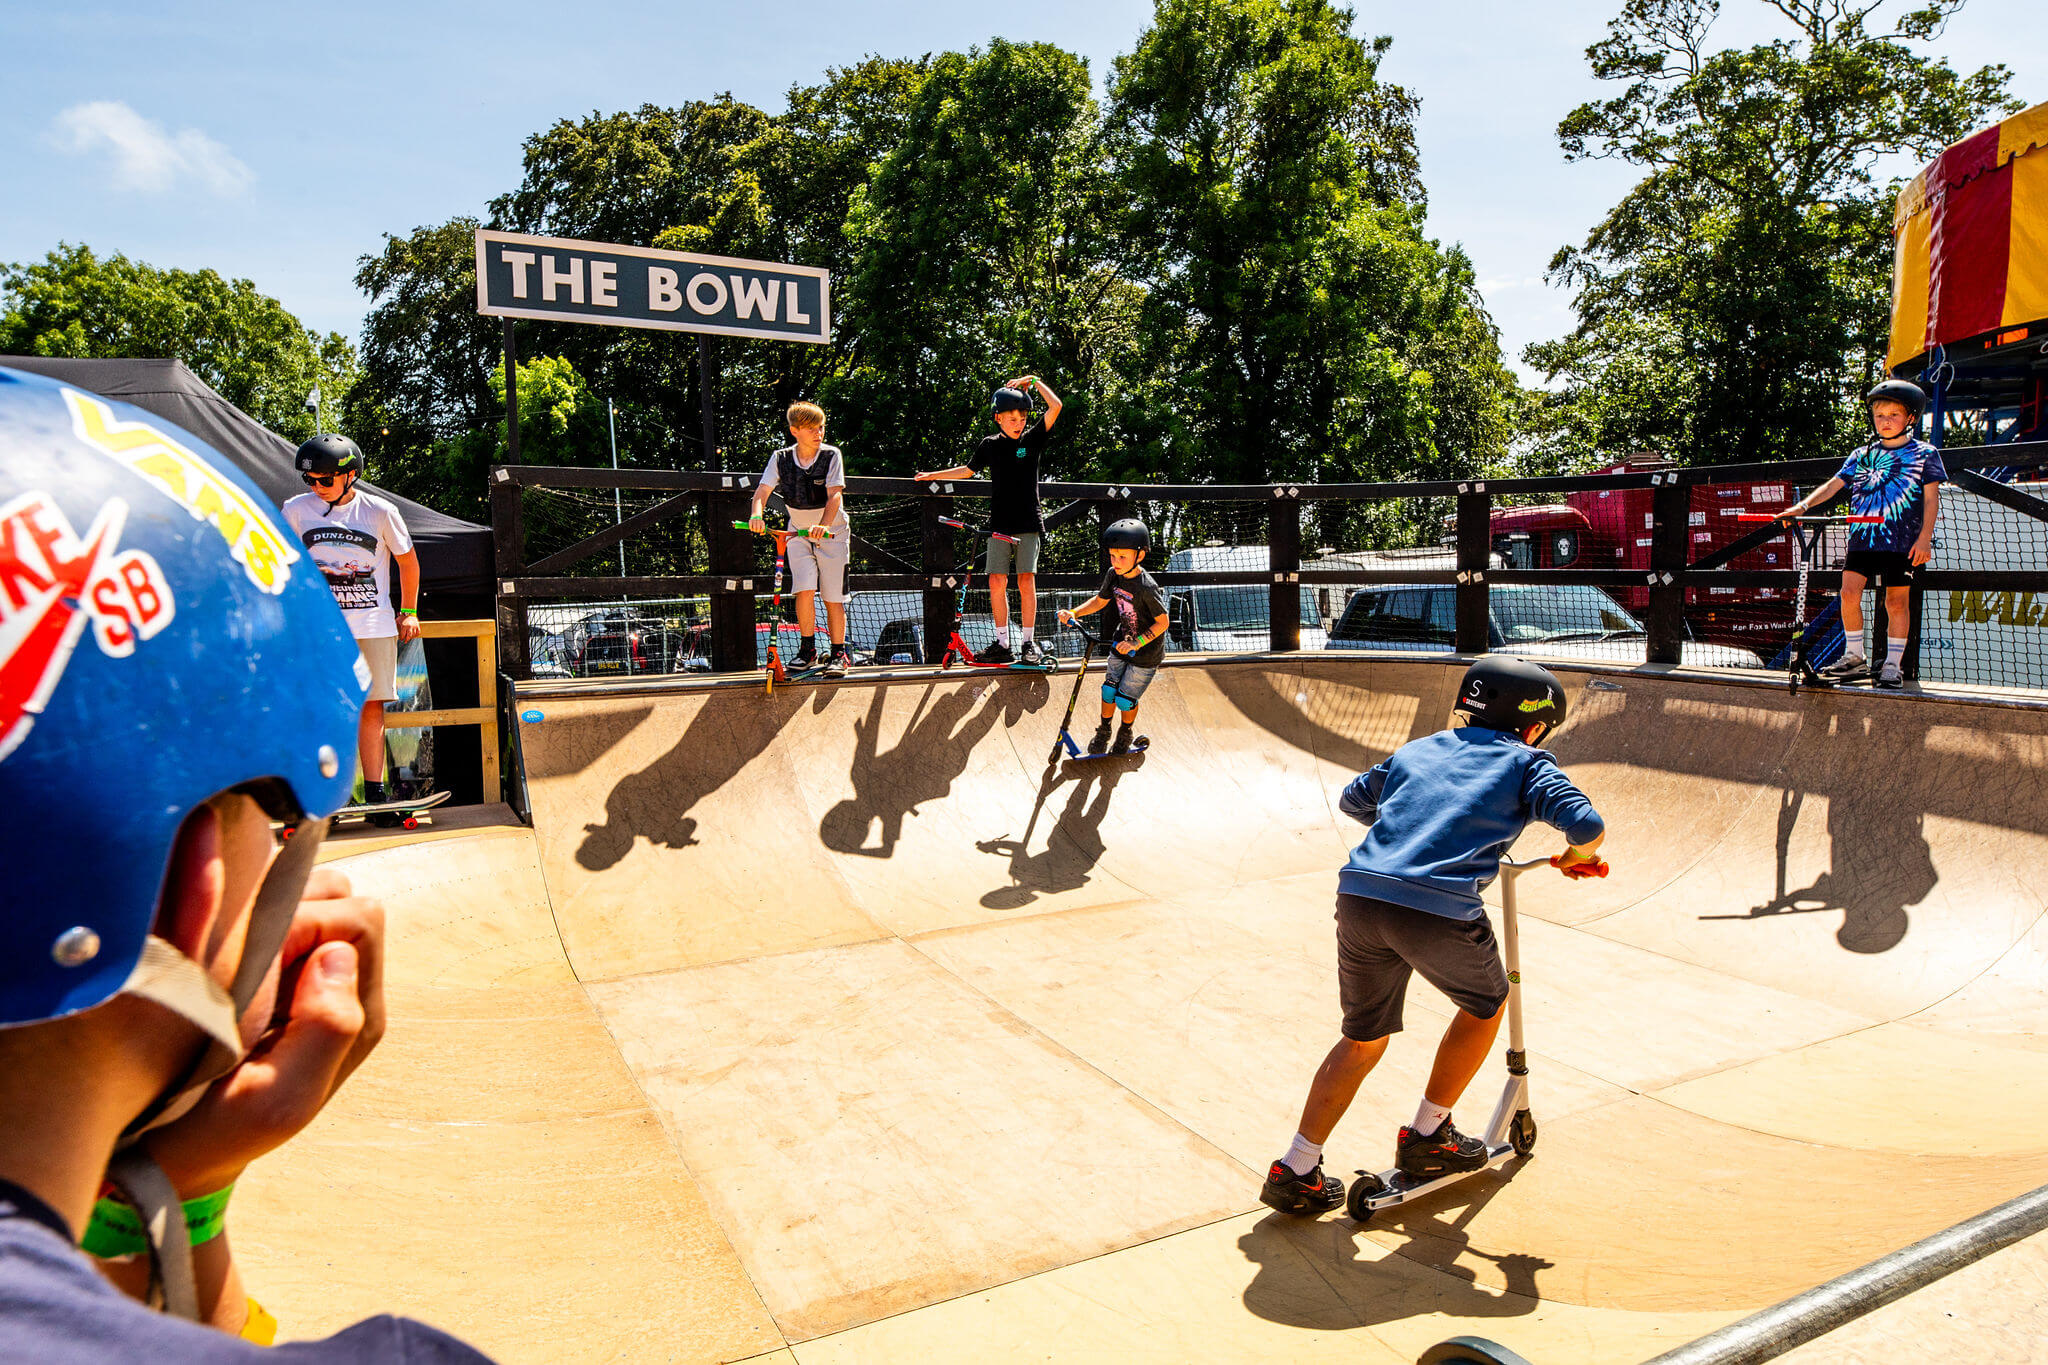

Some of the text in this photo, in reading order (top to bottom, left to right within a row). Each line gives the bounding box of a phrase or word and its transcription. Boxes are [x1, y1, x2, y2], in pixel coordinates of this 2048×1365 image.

[501, 249, 810, 325] THE BOWL
[70, 391, 291, 590] VANS
[0, 502, 162, 647] KE SB
[312, 532, 364, 543] DUNLOP
[1795, 561, 1809, 624] mongoose
